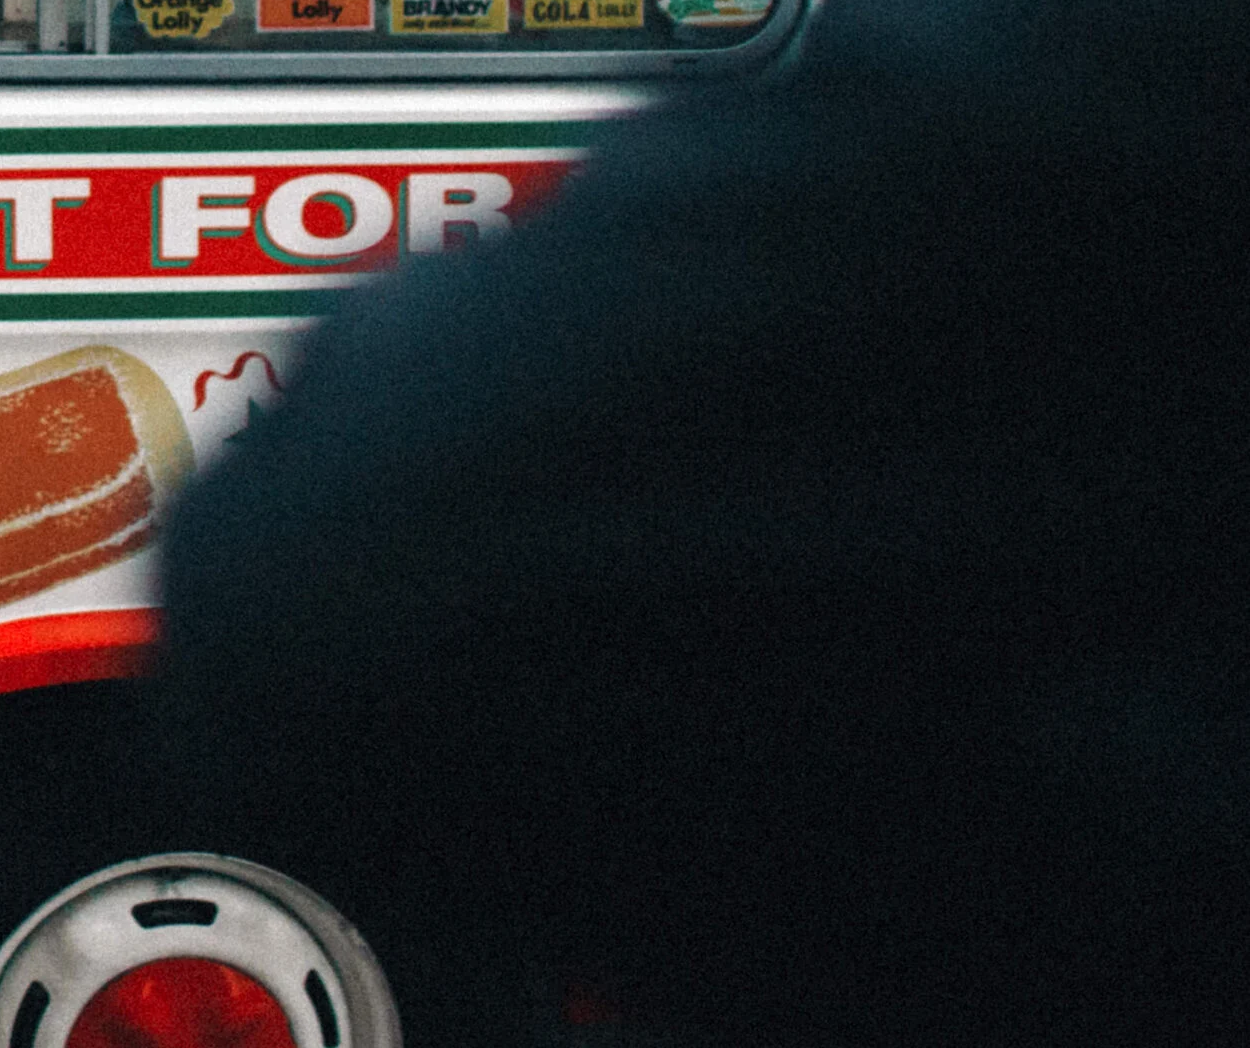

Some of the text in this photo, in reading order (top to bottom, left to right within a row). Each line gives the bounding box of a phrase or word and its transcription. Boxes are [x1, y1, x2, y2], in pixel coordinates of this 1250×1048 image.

[291, 0, 343, 23] Lolly
[403, 0, 493, 17] BRANDY
[533, 1, 591, 23] COLA
[152, 11, 204, 32] Lolly
[158, 171, 516, 264] FOR
